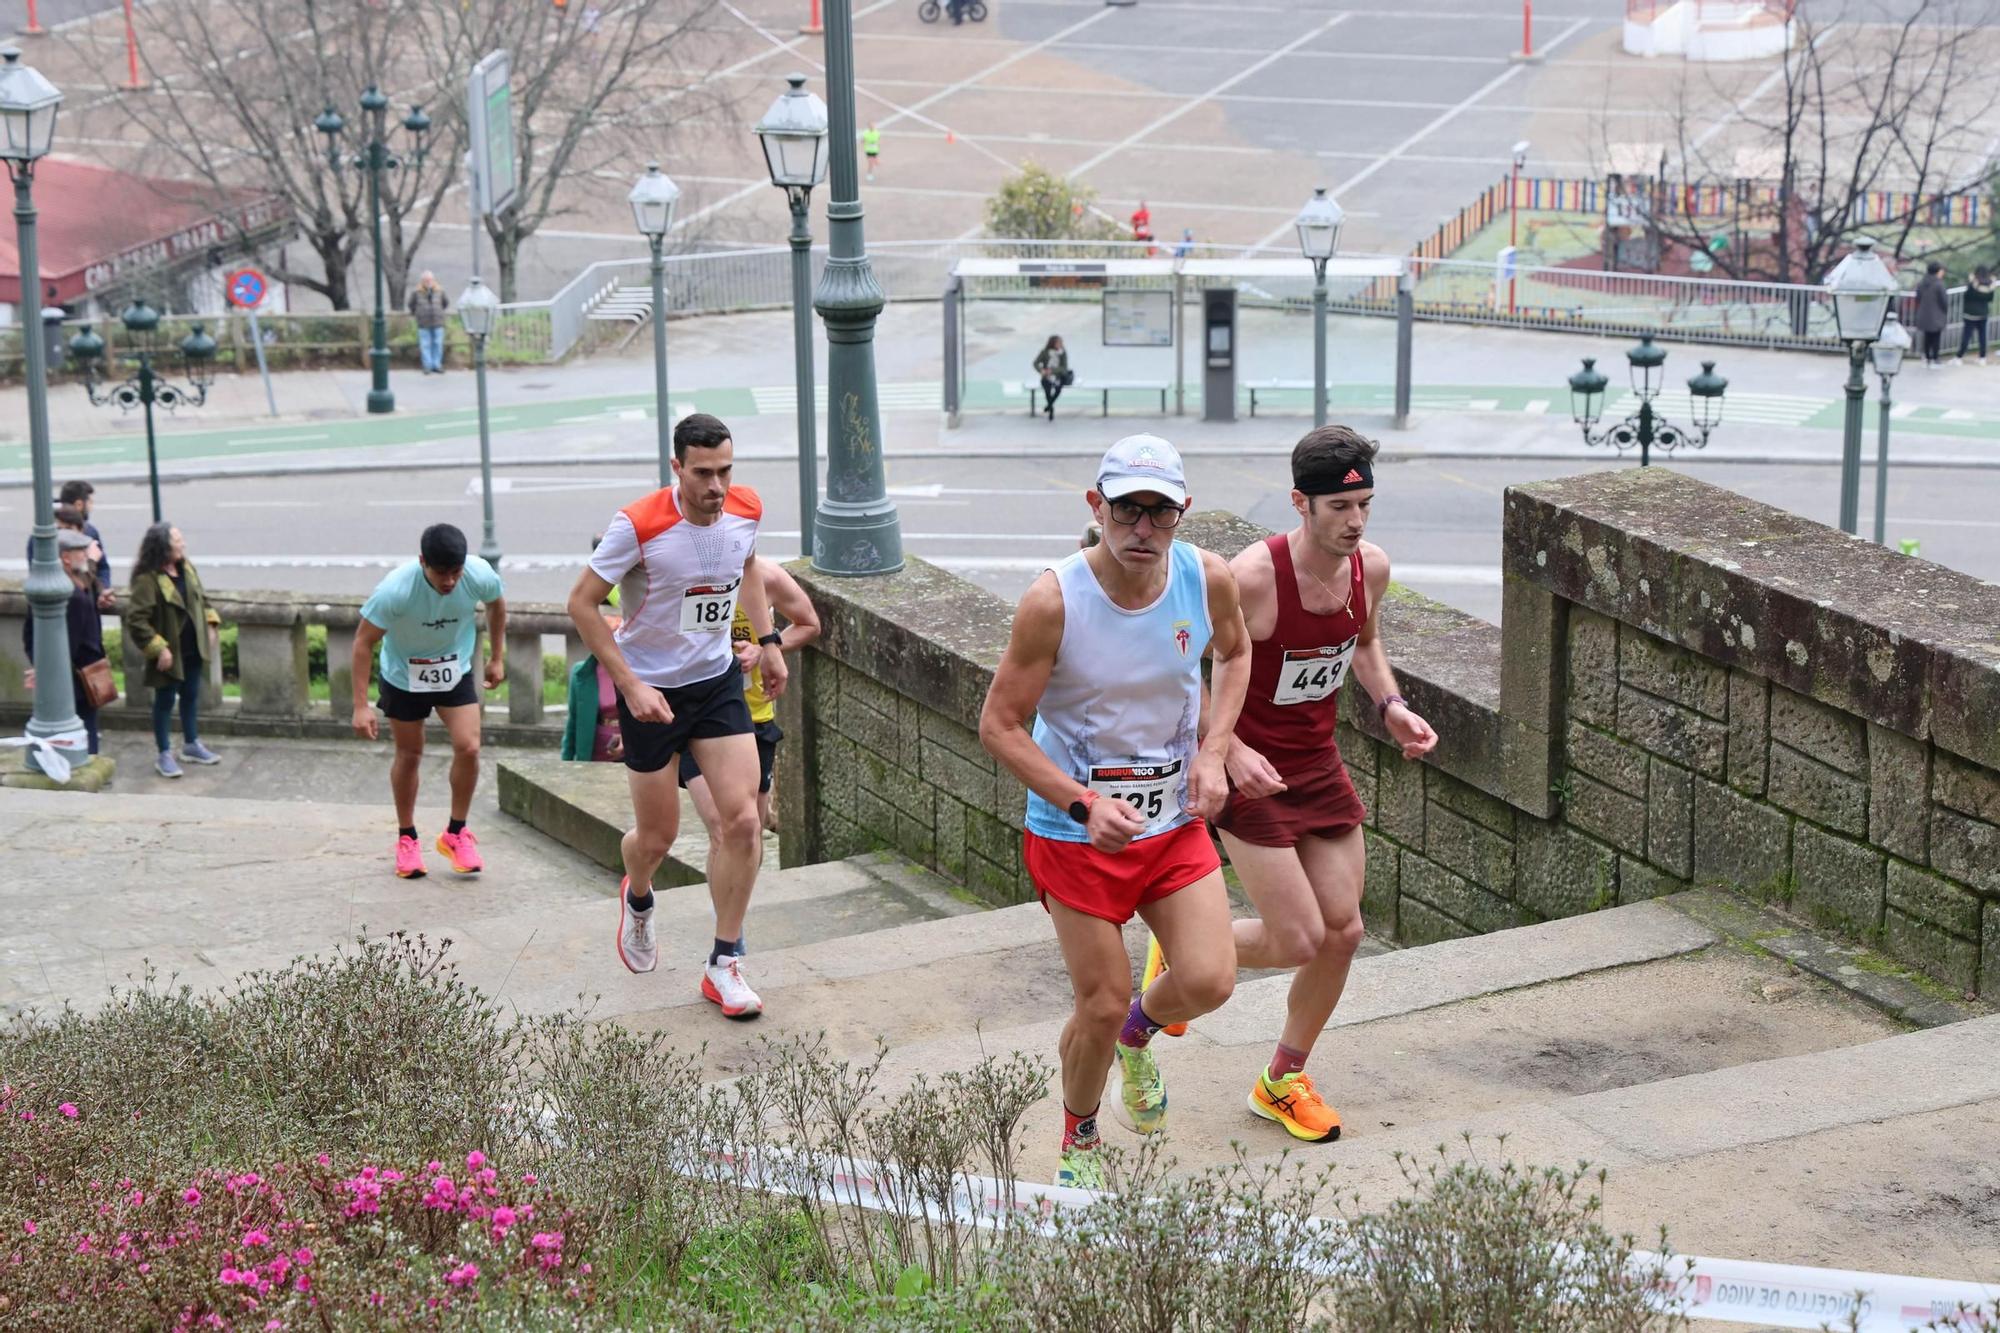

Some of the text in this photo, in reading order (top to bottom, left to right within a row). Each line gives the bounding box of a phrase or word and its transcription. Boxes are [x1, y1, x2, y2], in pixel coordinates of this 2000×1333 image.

[696, 600, 731, 623] 182
[419, 667, 453, 684] 430
[1292, 661, 1342, 690] 449
[1111, 789, 1163, 818] 25
